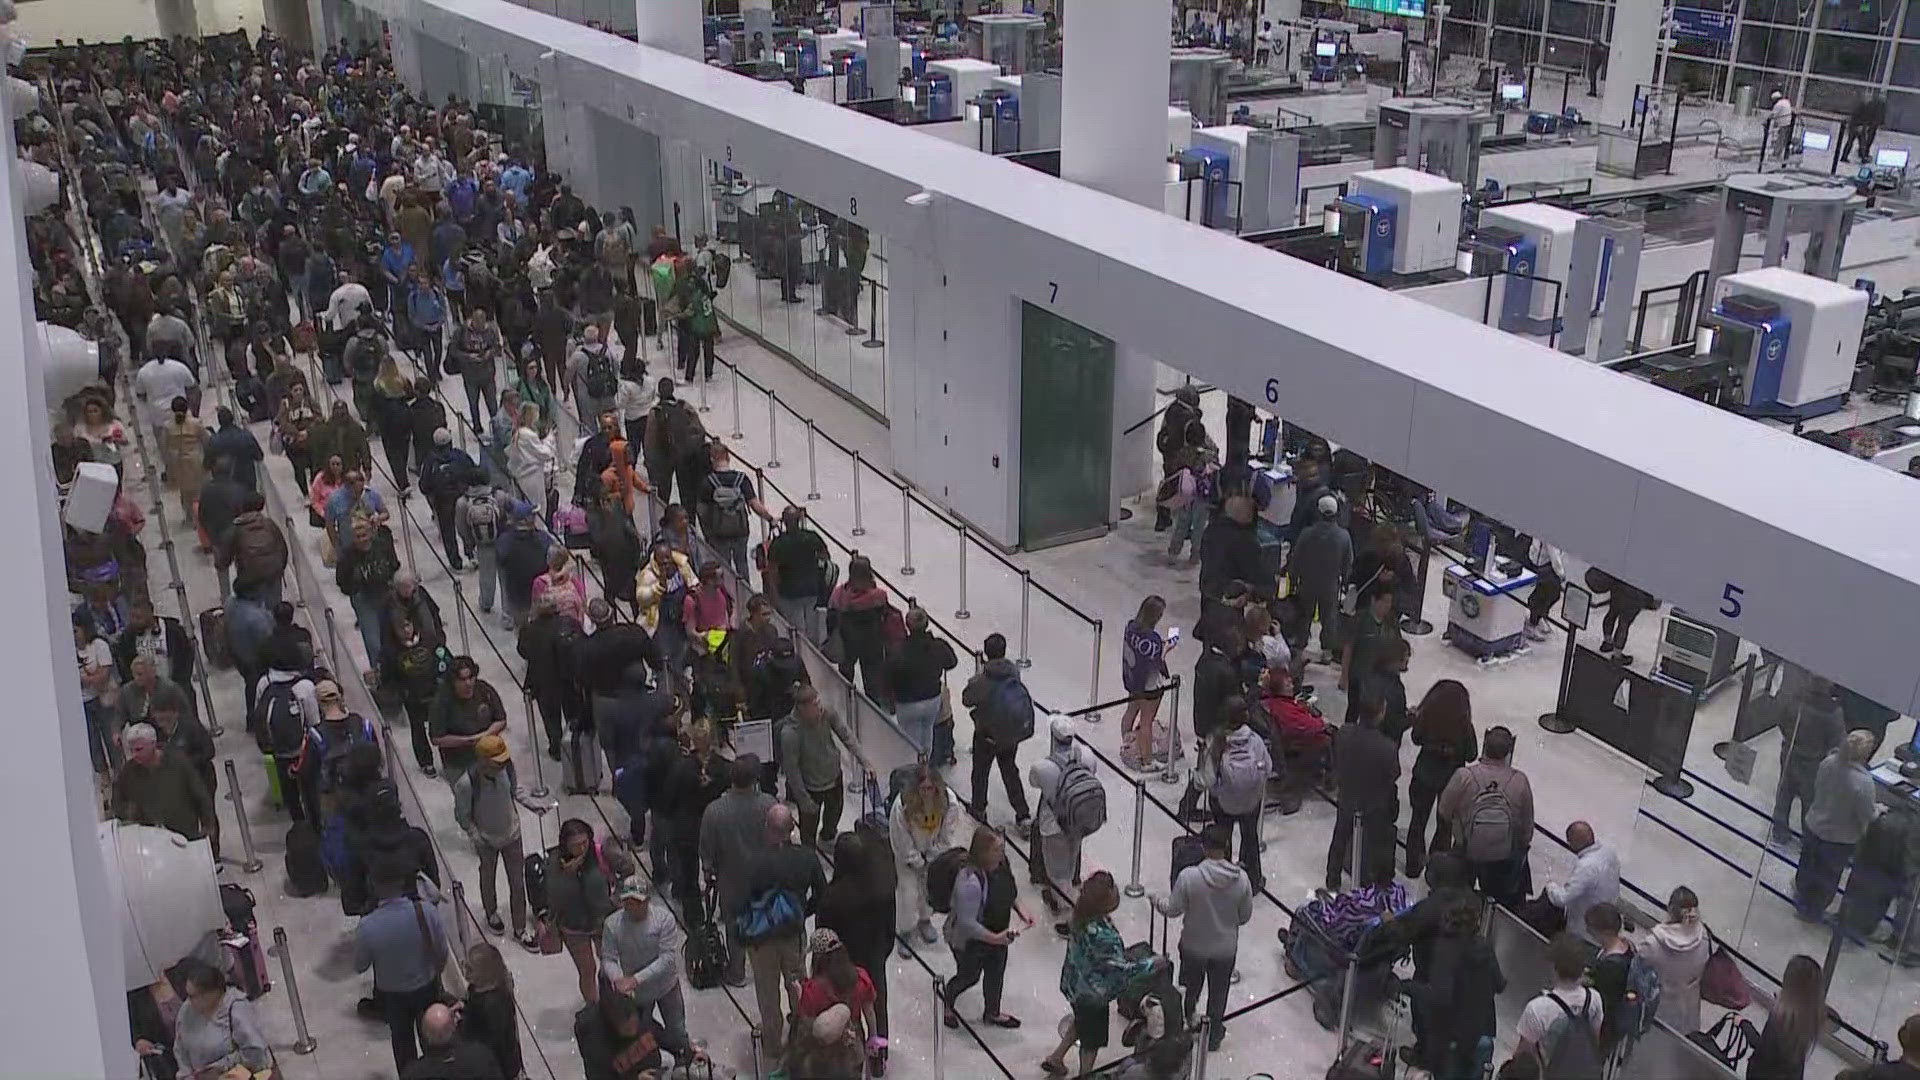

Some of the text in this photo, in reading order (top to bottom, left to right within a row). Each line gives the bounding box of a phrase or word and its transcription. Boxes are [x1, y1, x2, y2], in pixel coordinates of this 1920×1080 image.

[726, 146, 732, 162] 9
[850, 197, 857, 216] 8
[1049, 281, 1058, 304] 7
[1266, 378, 1279, 404] 6
[1719, 583, 1744, 618] 5
